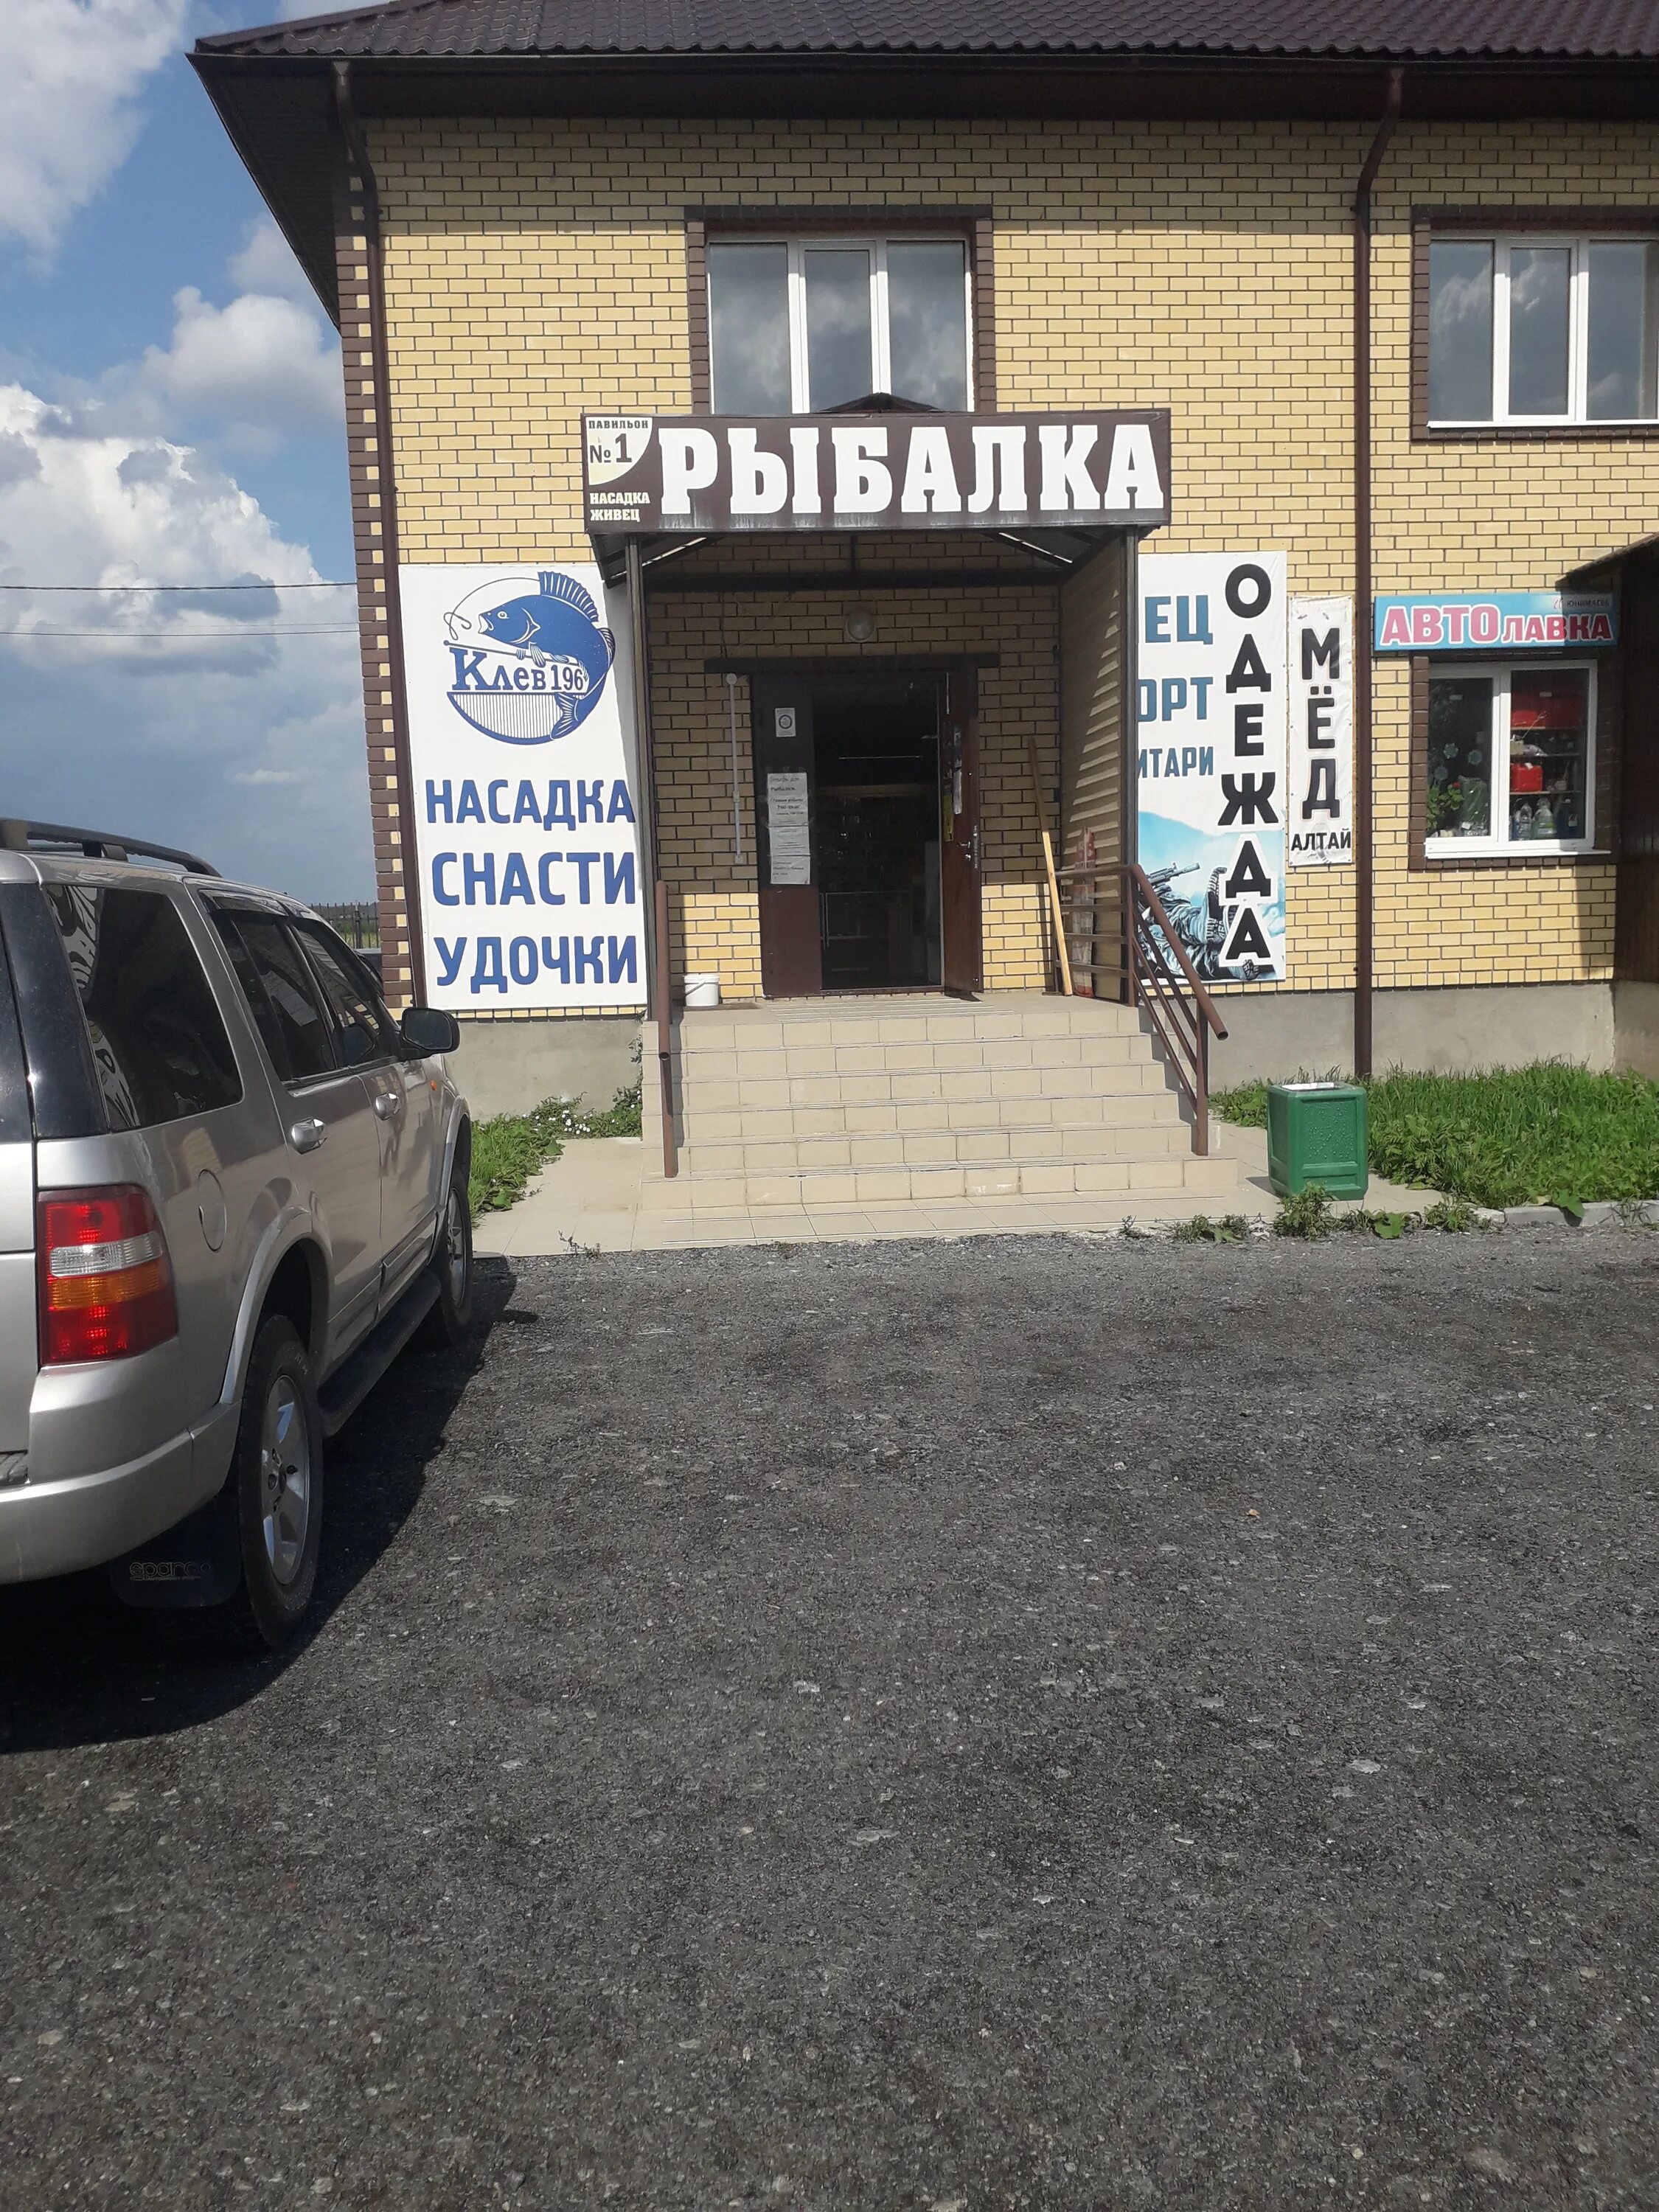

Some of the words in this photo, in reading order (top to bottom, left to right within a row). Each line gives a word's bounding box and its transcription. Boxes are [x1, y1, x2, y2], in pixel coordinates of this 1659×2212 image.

[588, 420, 649, 429] ПАВИЛЬОН
[657, 424, 1164, 515] РЫБАЛКА
[589, 492, 650, 506] НАСАДКА
[590, 509, 641, 522] ЖИВЕЦ
[1301, 627, 1340, 820] МЁД
[1218, 563, 1279, 960] ОДЕЖДА
[425, 779, 636, 831] НАСАДКА
[1291, 828, 1352, 852] АЛТАЙ
[431, 852, 636, 906] СНАСТИ
[434, 936, 639, 993] УДОЧКИ
